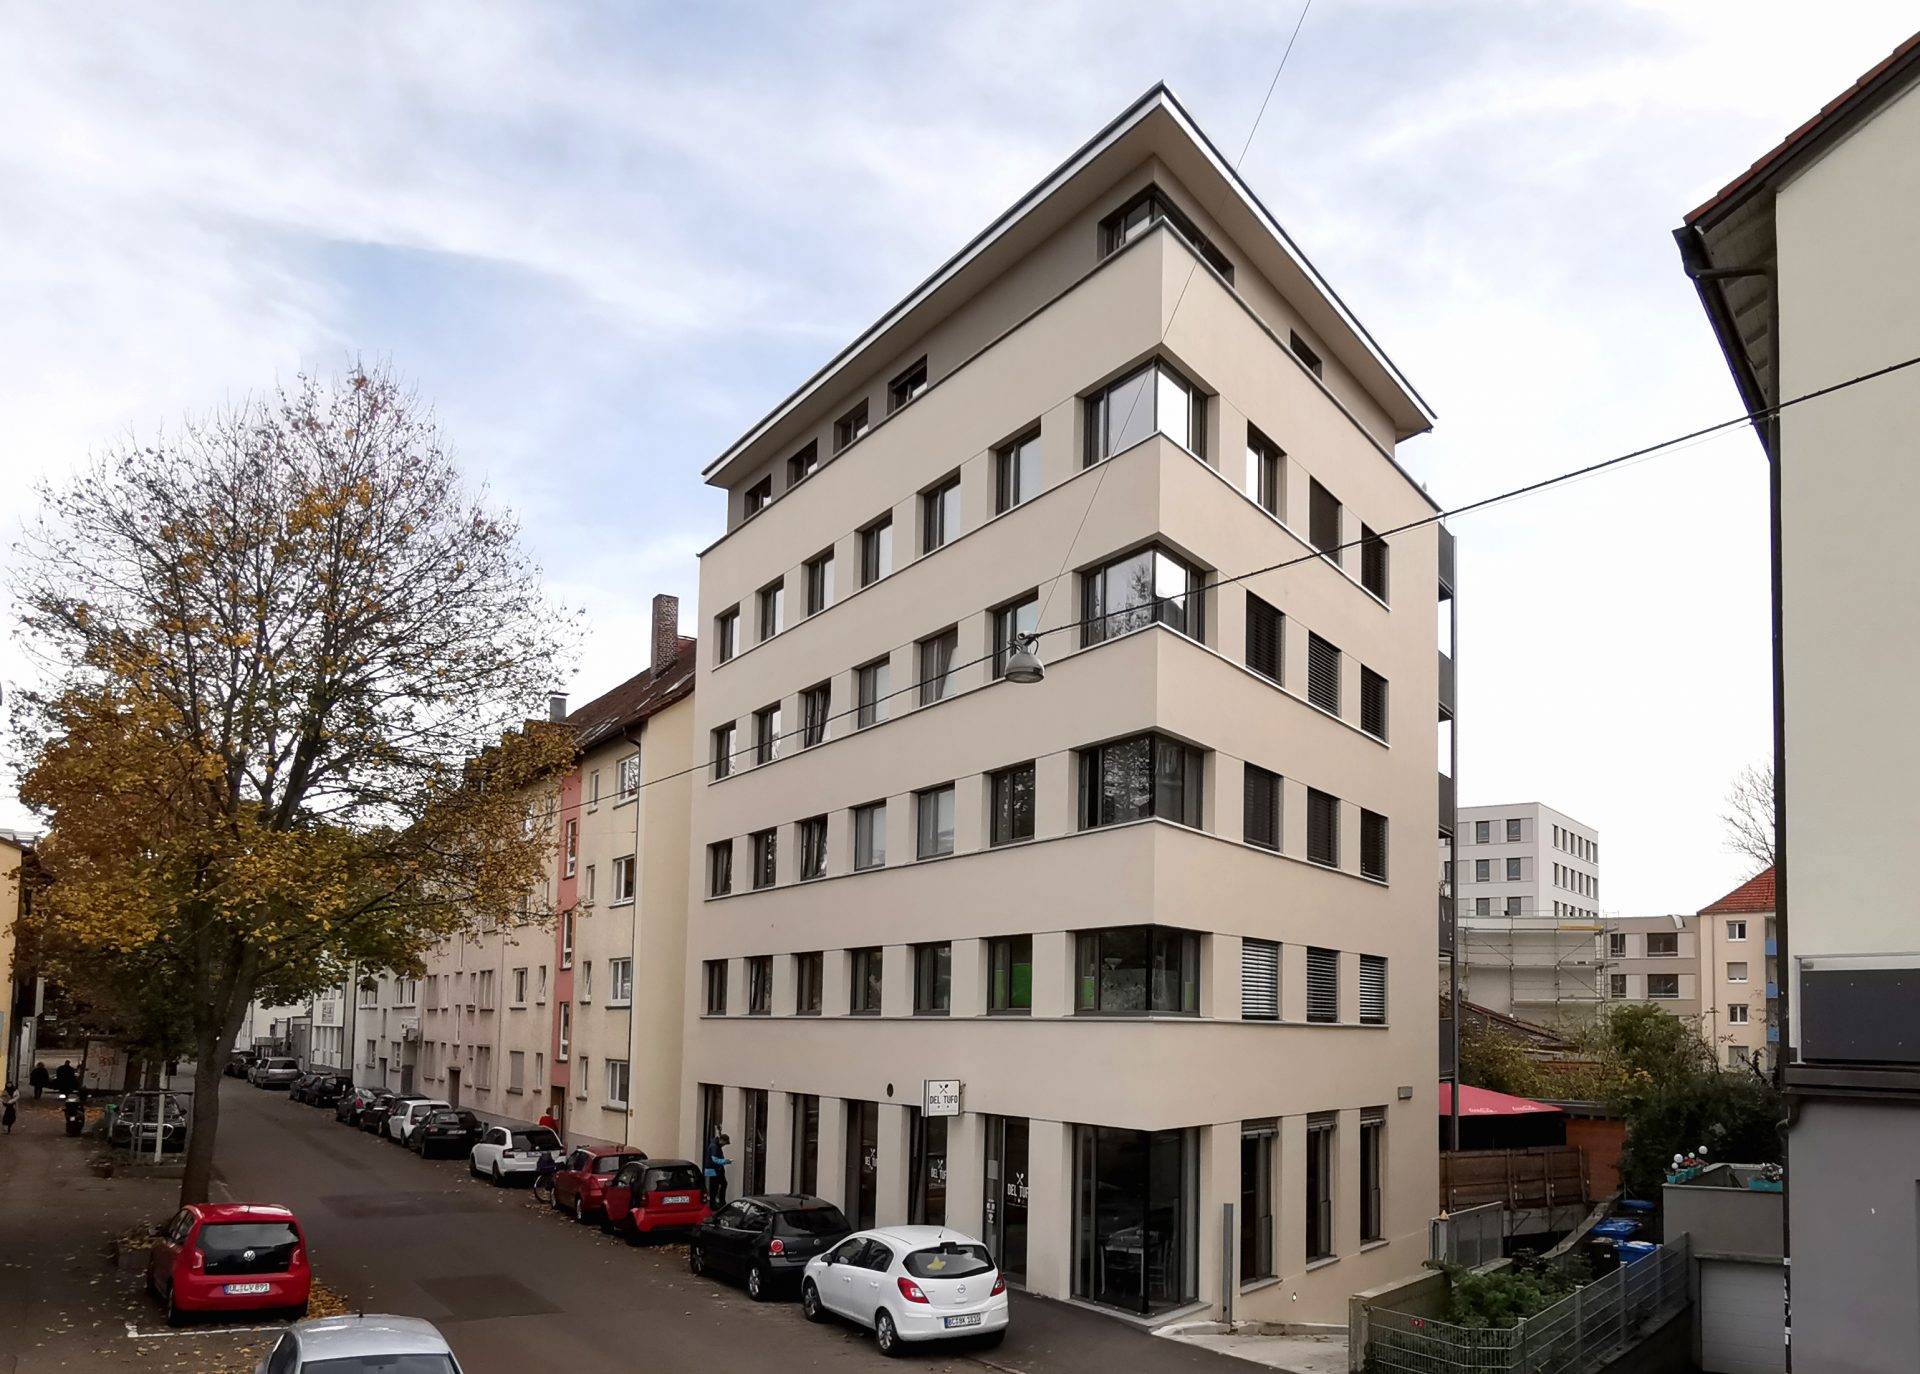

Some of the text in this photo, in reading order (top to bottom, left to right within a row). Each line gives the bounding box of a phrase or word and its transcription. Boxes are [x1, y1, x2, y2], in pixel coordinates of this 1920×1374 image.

[930, 1094, 958, 1104] DEL TUFO
[1007, 1183, 1028, 1199] DEL TUF
